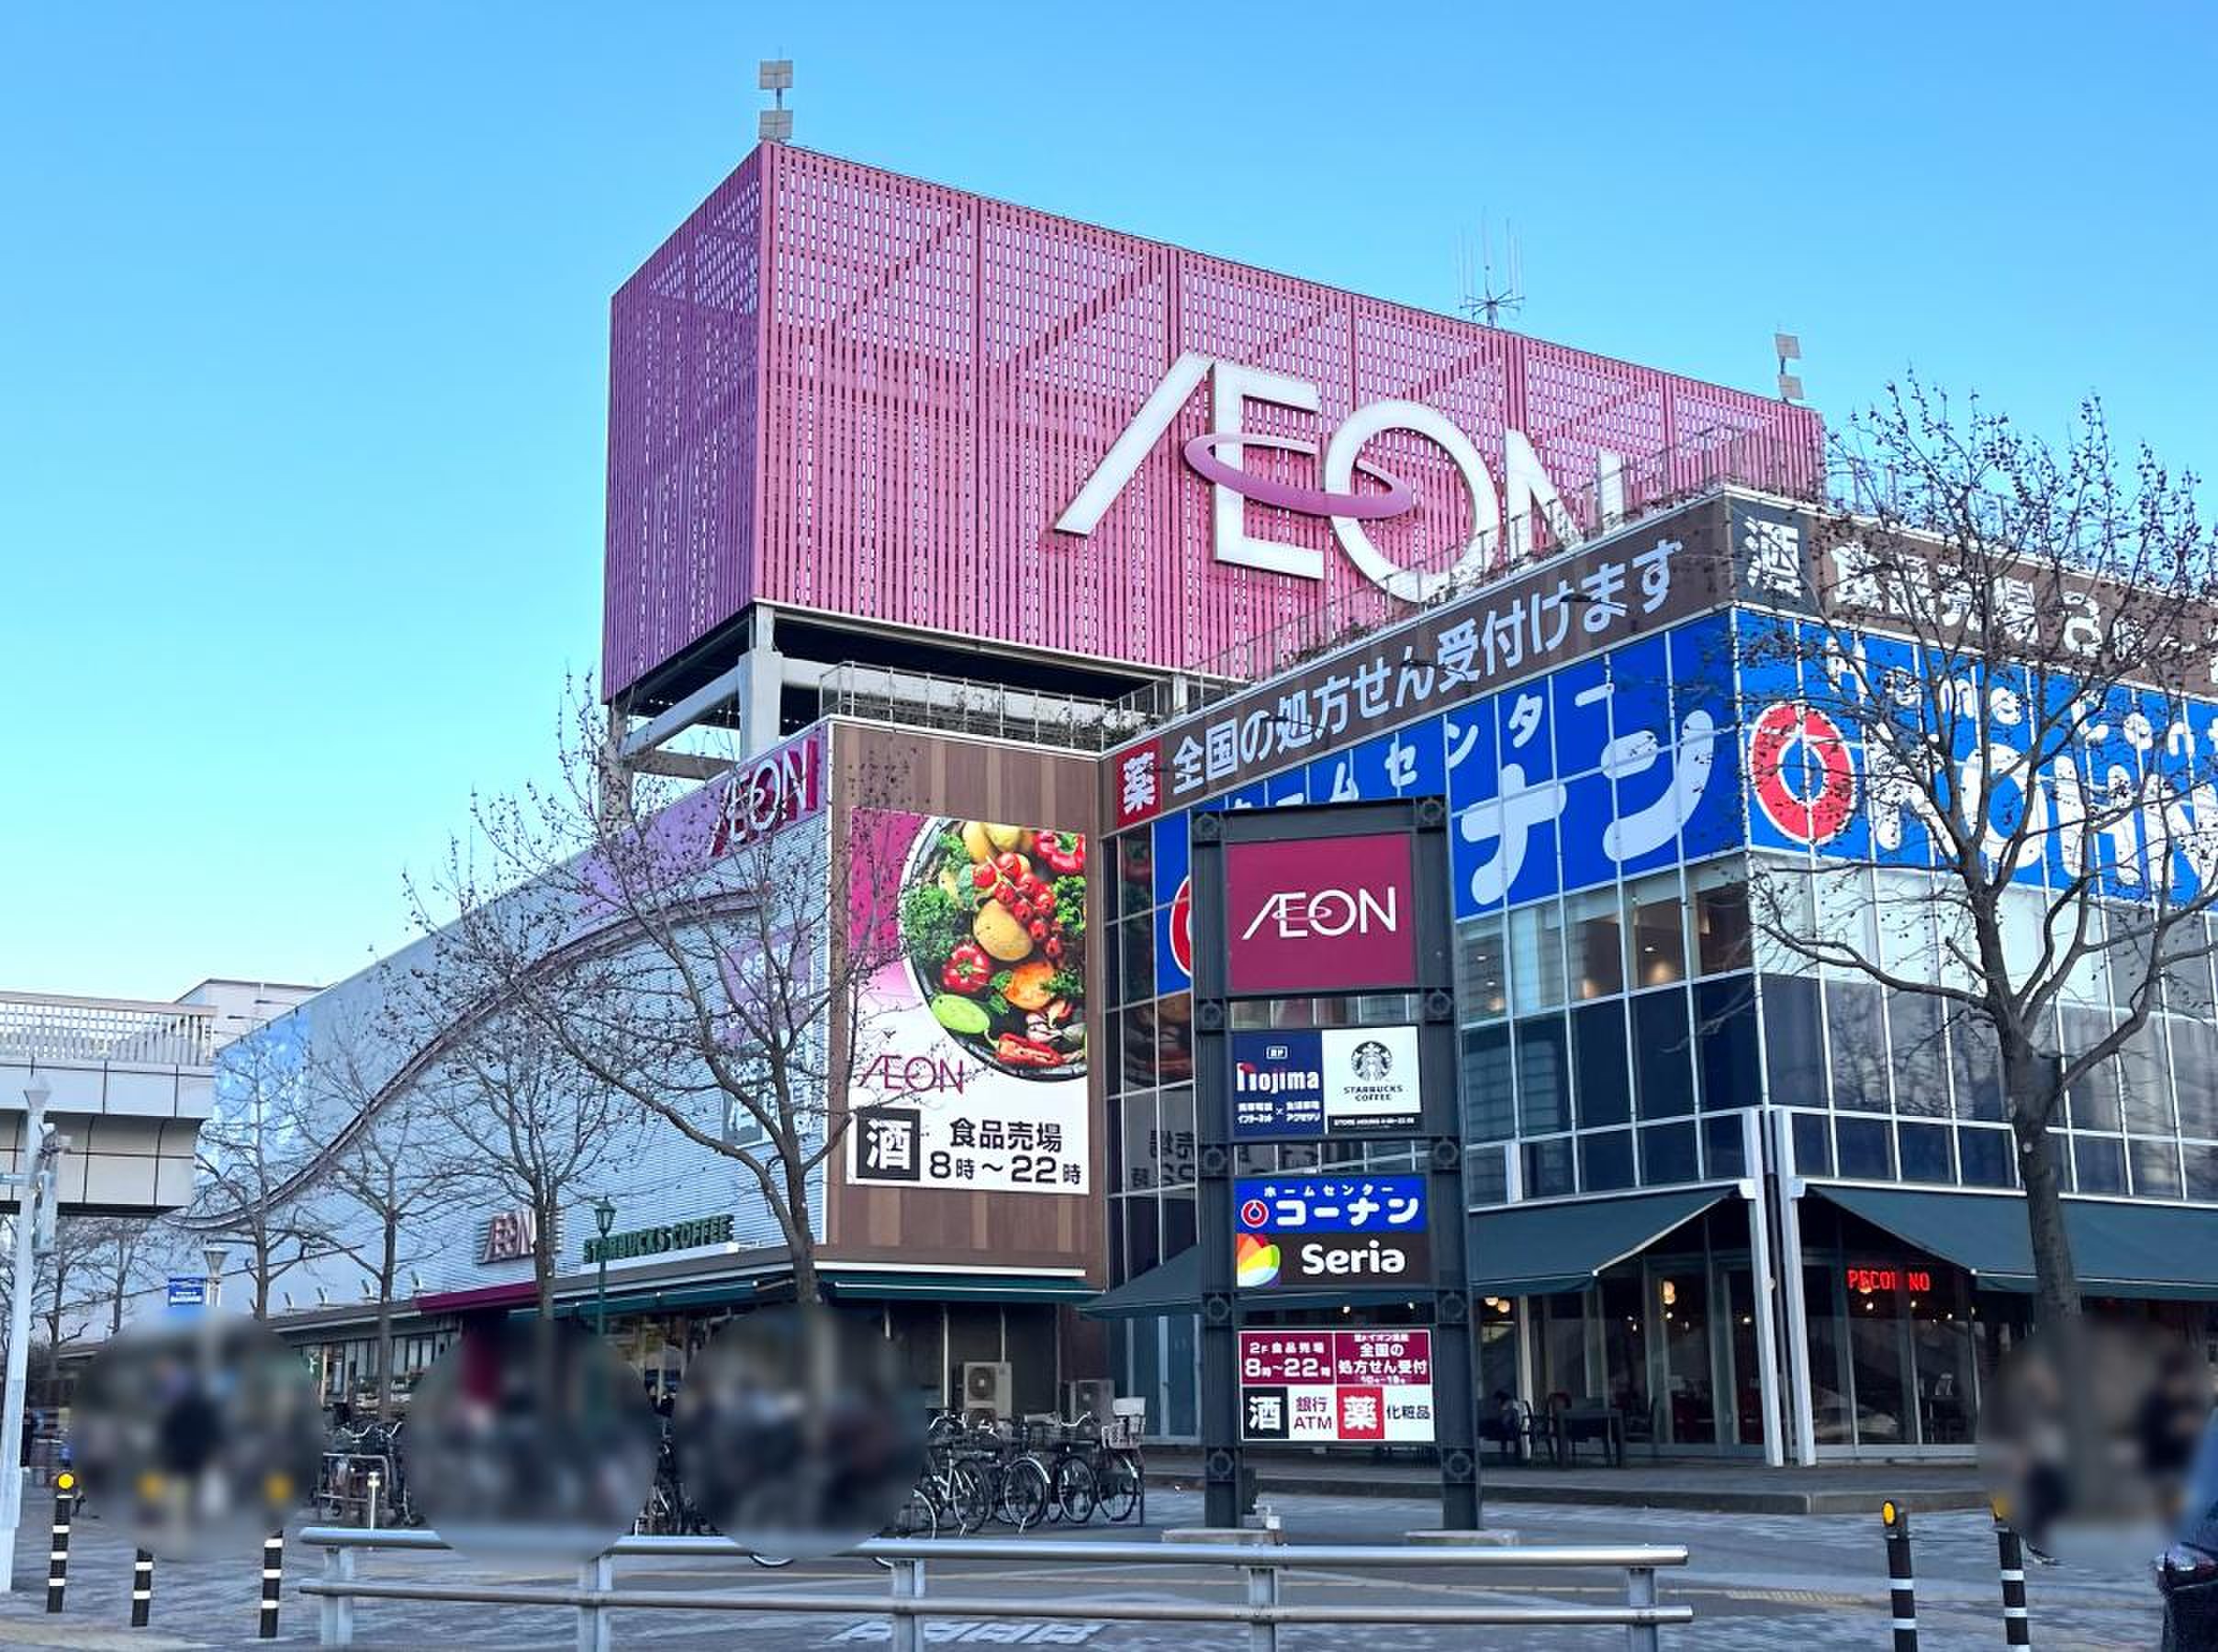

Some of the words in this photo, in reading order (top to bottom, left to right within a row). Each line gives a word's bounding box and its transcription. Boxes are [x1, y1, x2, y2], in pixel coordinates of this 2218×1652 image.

[1745, 516, 1800, 598] 酒
[1235, 683, 1614, 809] ームセンター
[1122, 750, 1157, 815] 薬
[1241, 887, 1396, 940] AEON
[857, 1055, 964, 1095] AEON
[1343, 1085, 1404, 1093] STARBUCKS
[866, 1118, 913, 1171] 酒
[949, 1117, 1063, 1154] 食品売場
[1263, 1184, 1395, 1198] ホームセンター
[1276, 1198, 1419, 1226] コーナン
[1302, 1239, 1406, 1274] Seria
[1360, 1343, 1405, 1357] 全国の
[1338, 1360, 1428, 1375] 処方せん受付
[1249, 1396, 1282, 1430] 酒
[1295, 1396, 1328, 1412] 銀行
[1343, 1395, 1377, 1430] 薬
[1386, 1405, 1430, 1420] 化粧品
[1294, 1416, 1332, 1429] ATM
